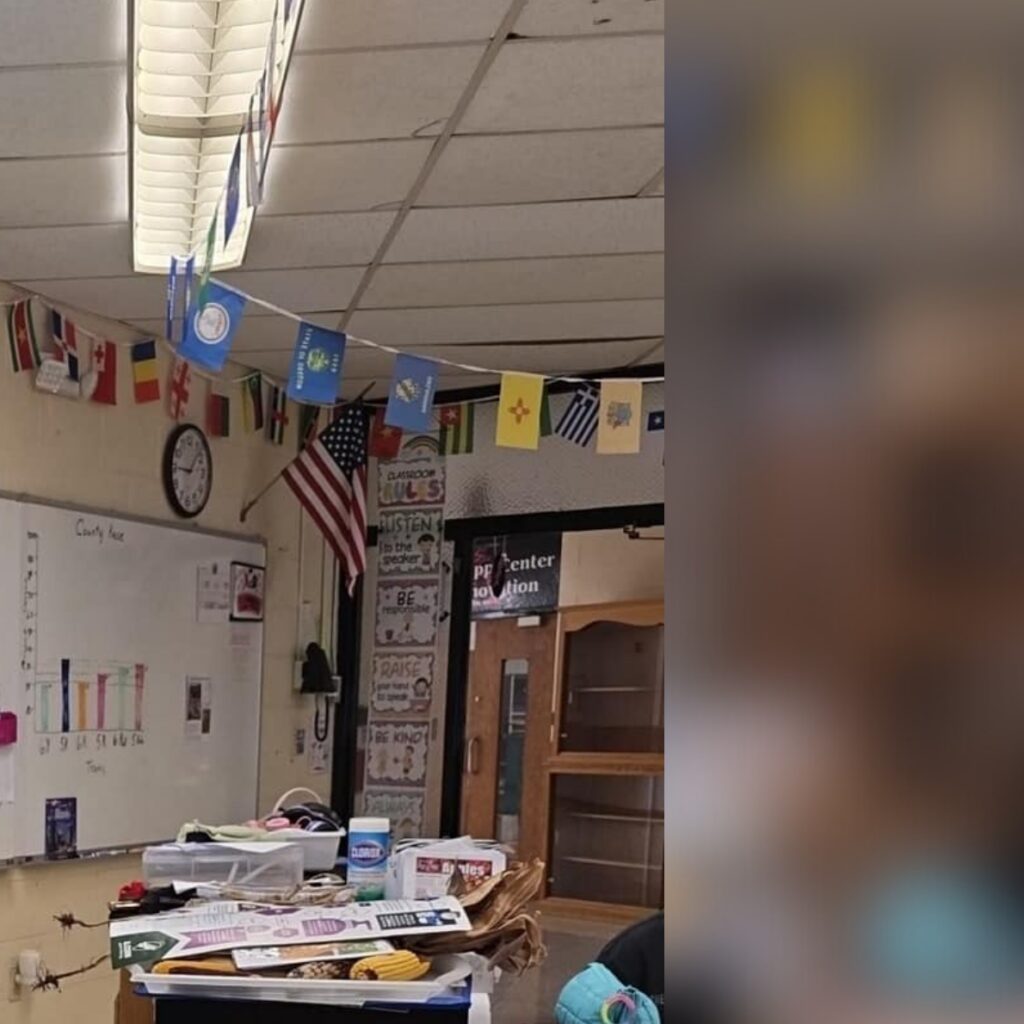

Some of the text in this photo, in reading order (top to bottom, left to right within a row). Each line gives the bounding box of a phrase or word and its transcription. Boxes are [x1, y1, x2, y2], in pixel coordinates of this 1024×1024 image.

[387, 468, 436, 481] CLASSROOM
[382, 479, 440, 500] RULES
[385, 516, 433, 533] LISTEN
[395, 541, 413, 552] the
[382, 553, 421, 566] speaker
[397, 590, 416, 606] BE
[380, 661, 422, 678] RAISE
[375, 730, 423, 744] BE KIND
